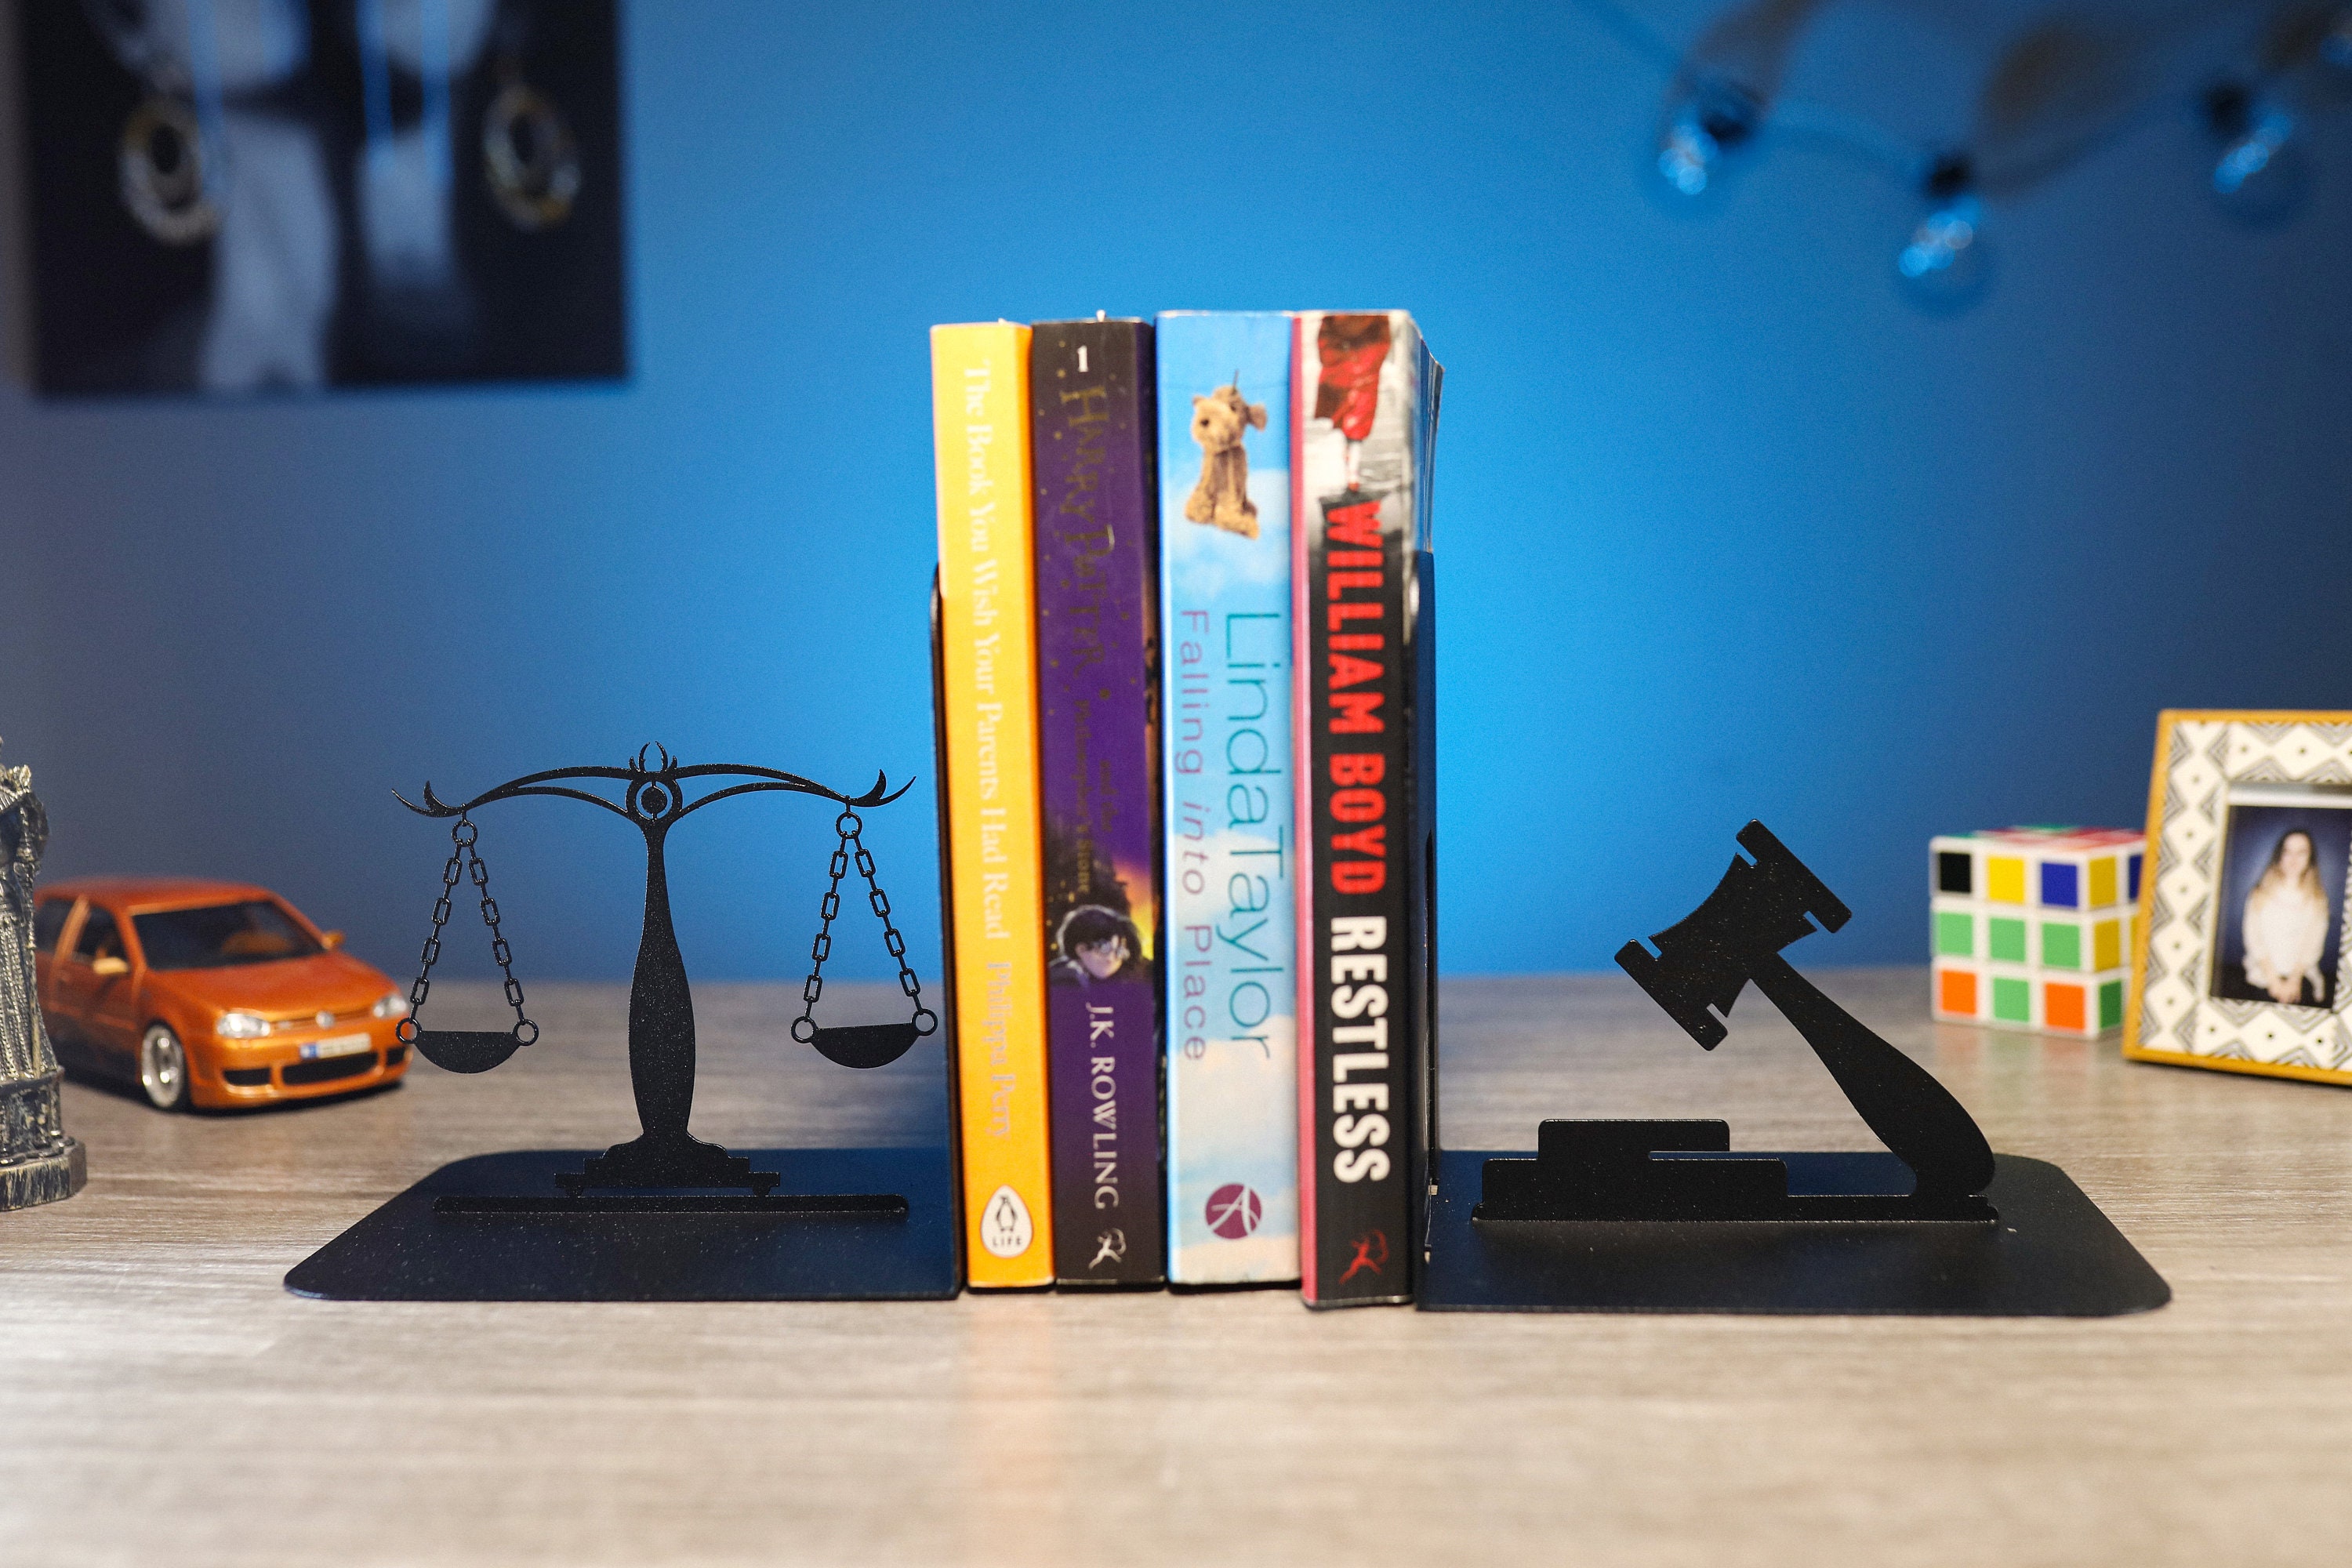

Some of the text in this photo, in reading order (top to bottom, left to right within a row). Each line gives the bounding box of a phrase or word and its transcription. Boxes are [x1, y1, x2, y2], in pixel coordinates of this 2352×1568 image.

[964, 359, 1010, 939] The Book You Wish Your Parents Had Read
[1325, 500, 1386, 895] WILLIAM BOYD
[1174, 610, 1211, 1060] Falling into Place
[981, 962, 1015, 1139] Philippa Perry
[1085, 1002, 1119, 1210] J.K. ROWLING
[1330, 916, 1391, 1184] RESTLESS
[992, 1236, 1022, 1247] LIFE
